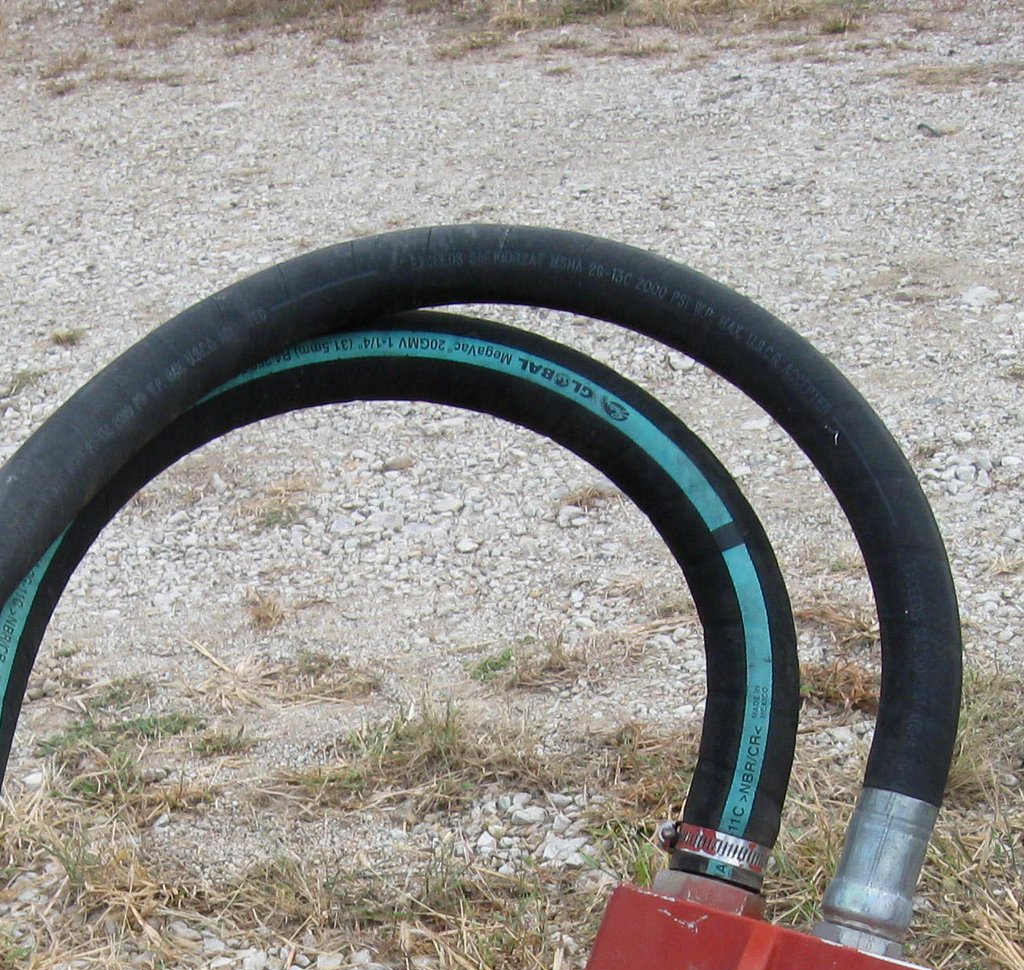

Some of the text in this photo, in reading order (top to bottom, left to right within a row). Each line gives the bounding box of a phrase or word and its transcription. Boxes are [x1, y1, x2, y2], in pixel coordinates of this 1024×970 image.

[550, 253, 584, 274] MSHA
[588, 262, 632, 287] 2G-13C
[635, 278, 668, 299] 2000
[670, 290, 691, 310] PSI
[398, 336, 446, 350] 20GMV
[453, 341, 513, 365] MegaVac
[518, 357, 594, 399] GLOBAL
[740, 726, 763, 804] >NBR/CR<
